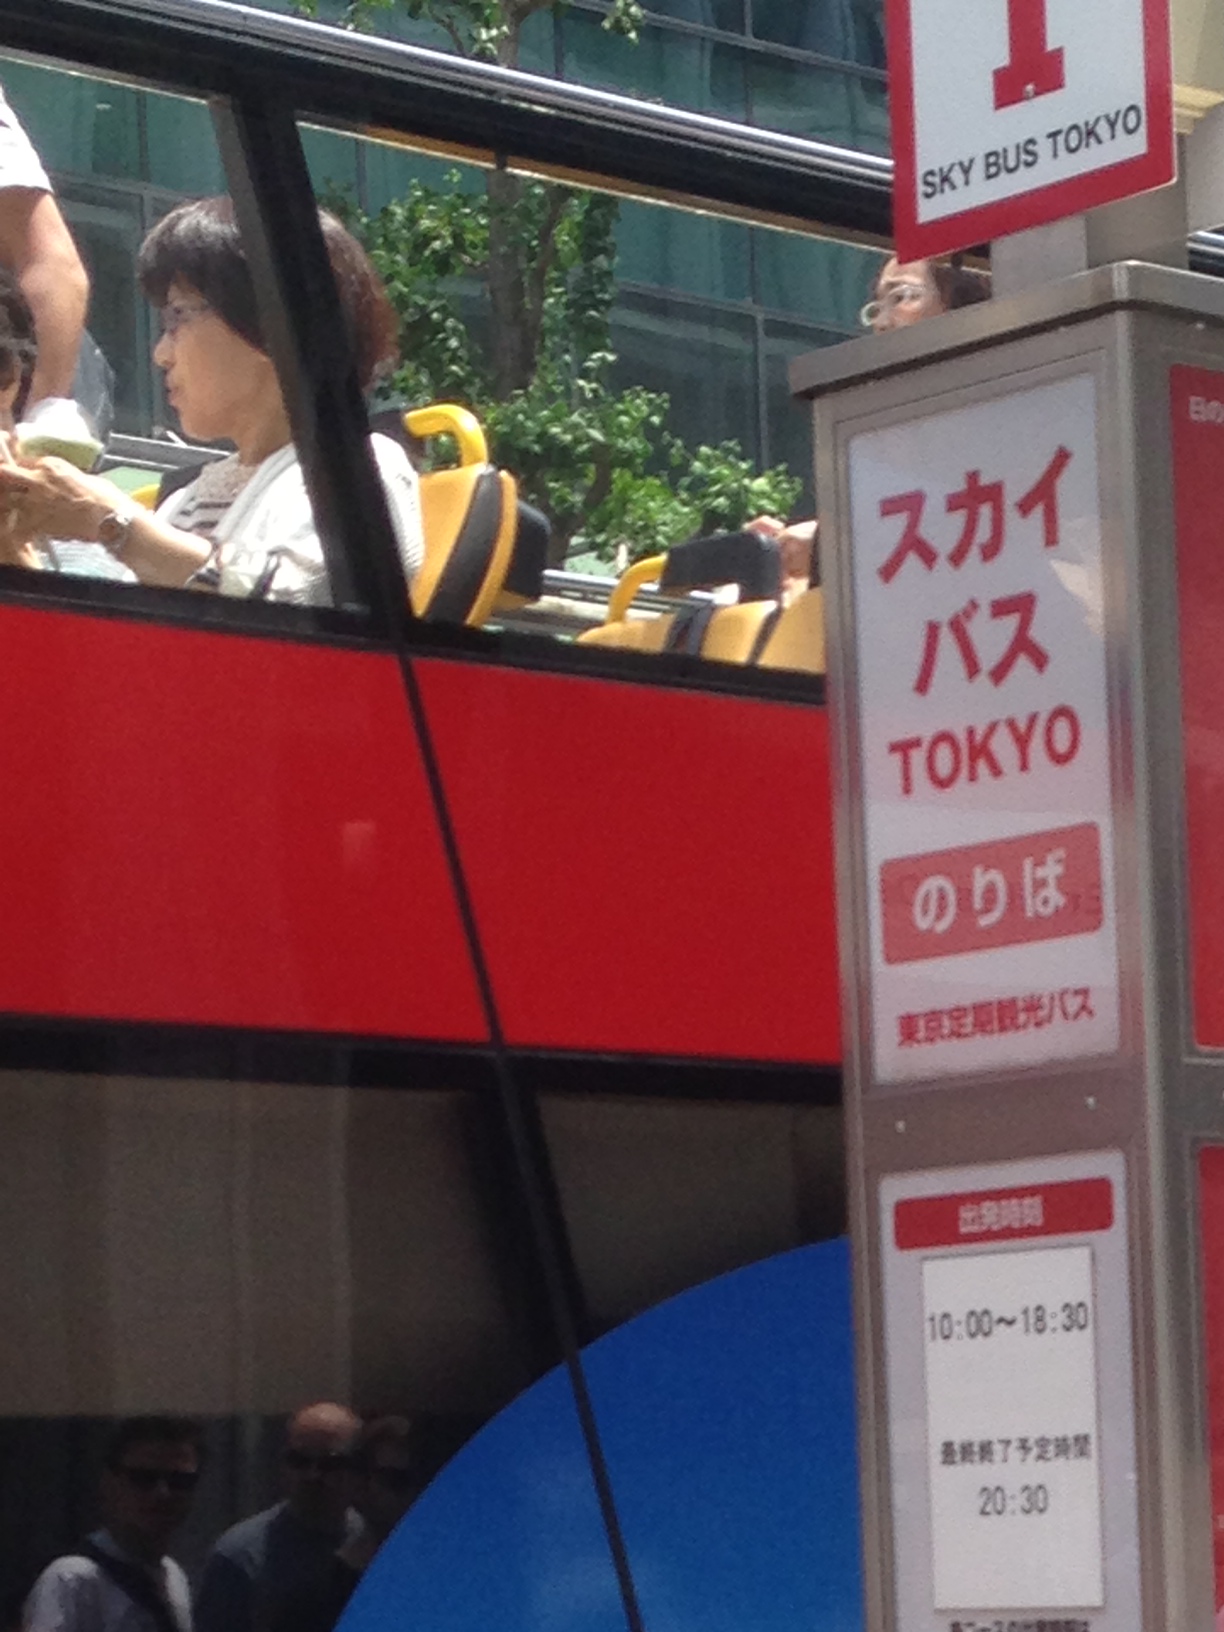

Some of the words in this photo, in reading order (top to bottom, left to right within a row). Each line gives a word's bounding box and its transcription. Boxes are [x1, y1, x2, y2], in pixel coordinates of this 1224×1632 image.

[921, 157, 975, 199] SKY
[984, 137, 1038, 181] BUS
[1046, 103, 1142, 159] TOKYO
[877, 445, 1073, 585] スカイ
[913, 590, 1050, 698] バス
[888, 703, 1082, 797] TOKYO
[913, 848, 1067, 935] のりば
[979, 1483, 1049, 1516] 20:30
